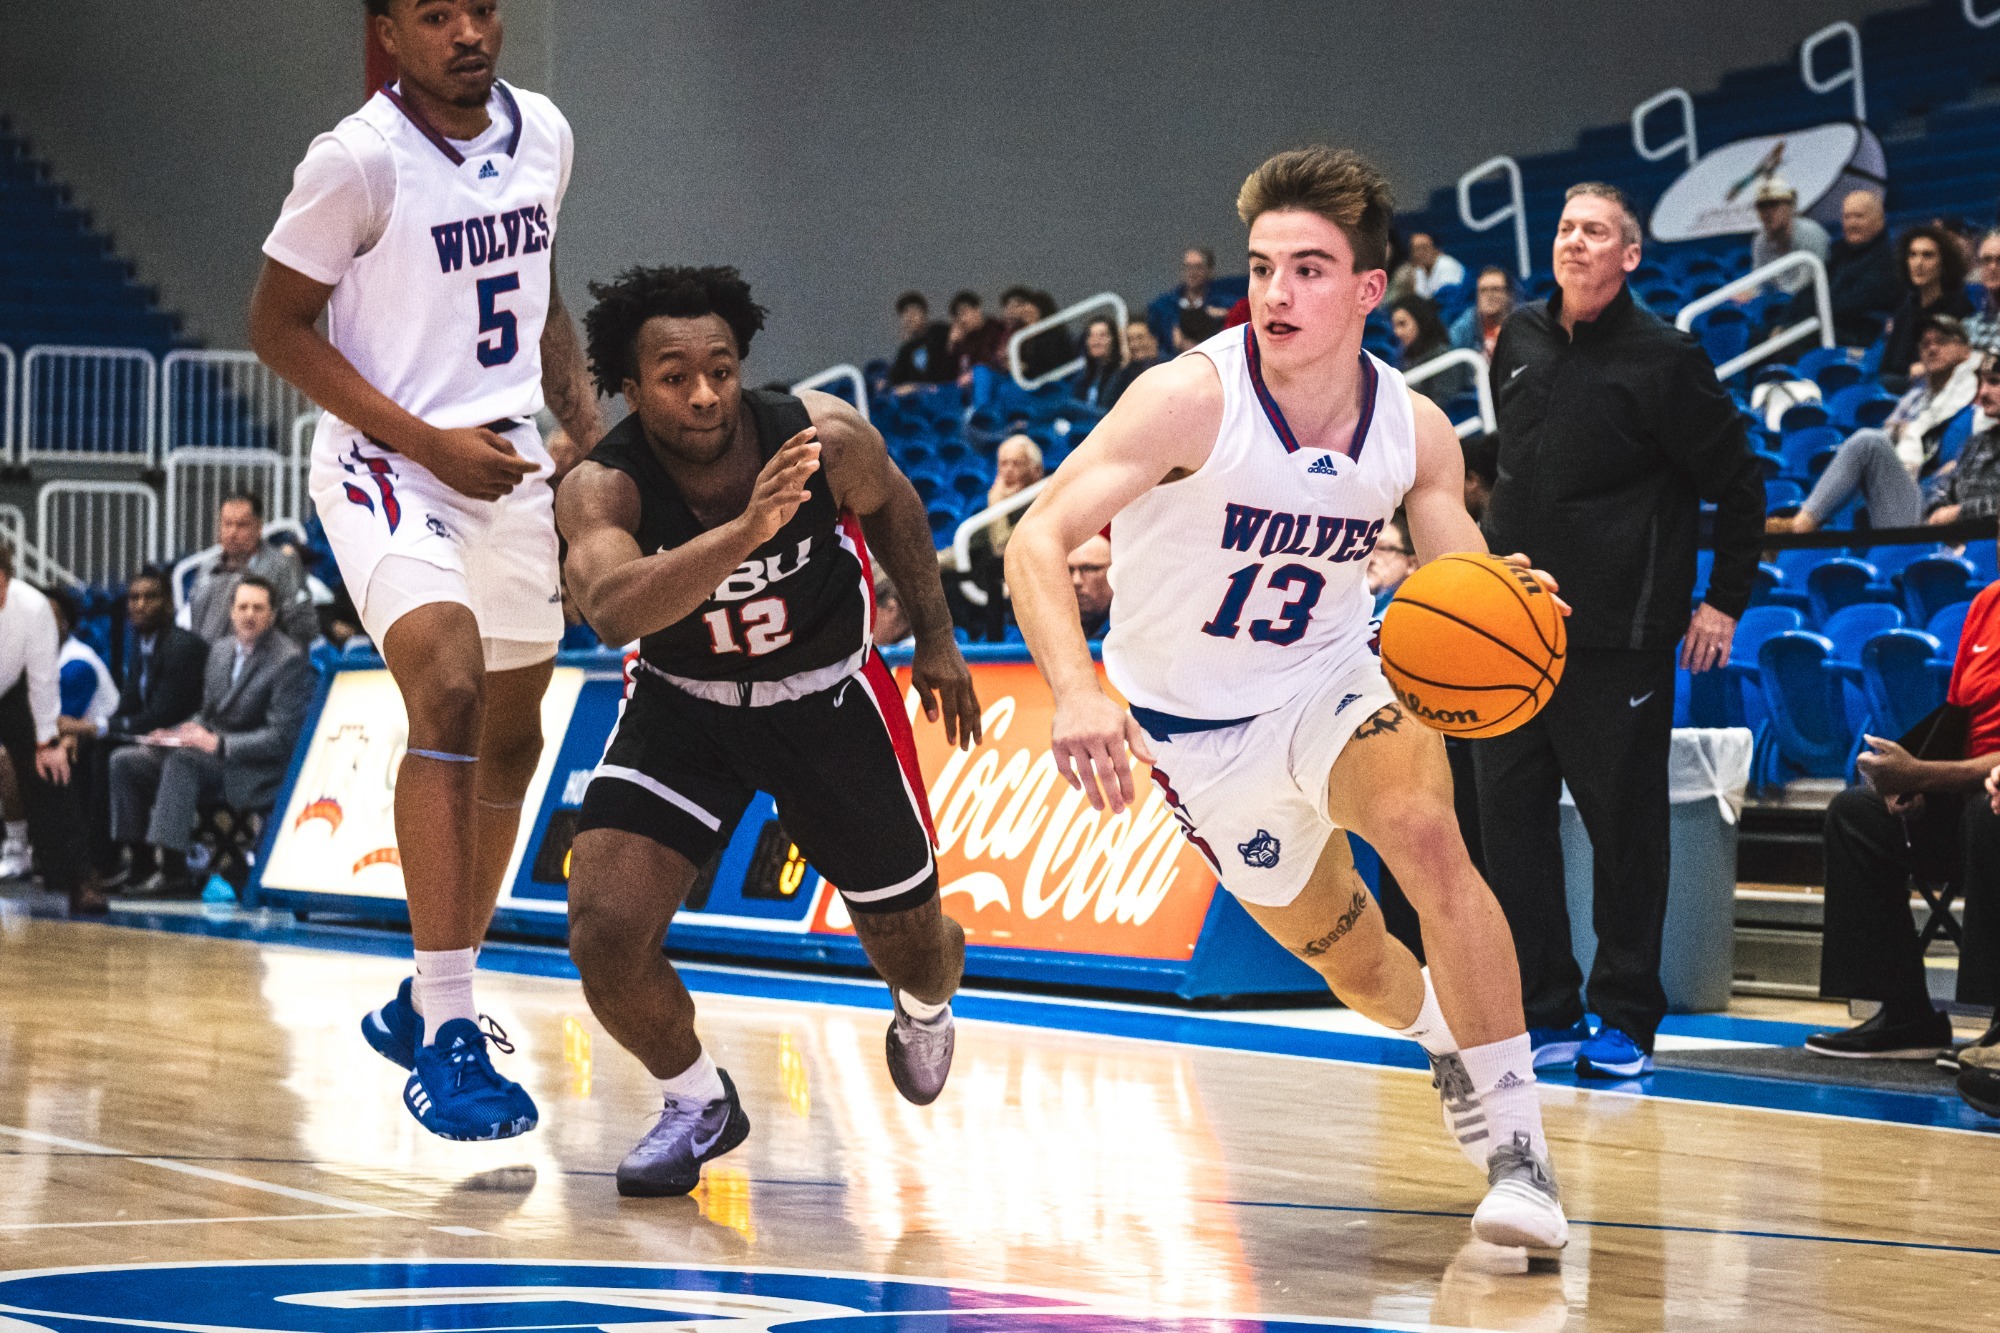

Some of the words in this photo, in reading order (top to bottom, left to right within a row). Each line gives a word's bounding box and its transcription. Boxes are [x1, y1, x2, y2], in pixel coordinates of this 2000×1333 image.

[430, 203, 550, 274] WOLVES
[476, 271, 520, 368] 5
[1307, 466, 1338, 477] adidas
[1221, 502, 1385, 563] WOLVES
[709, 536, 813, 602] BU
[702, 595, 794, 657] 12
[1201, 562, 1327, 646] 13
[1388, 680, 1480, 724] lson
